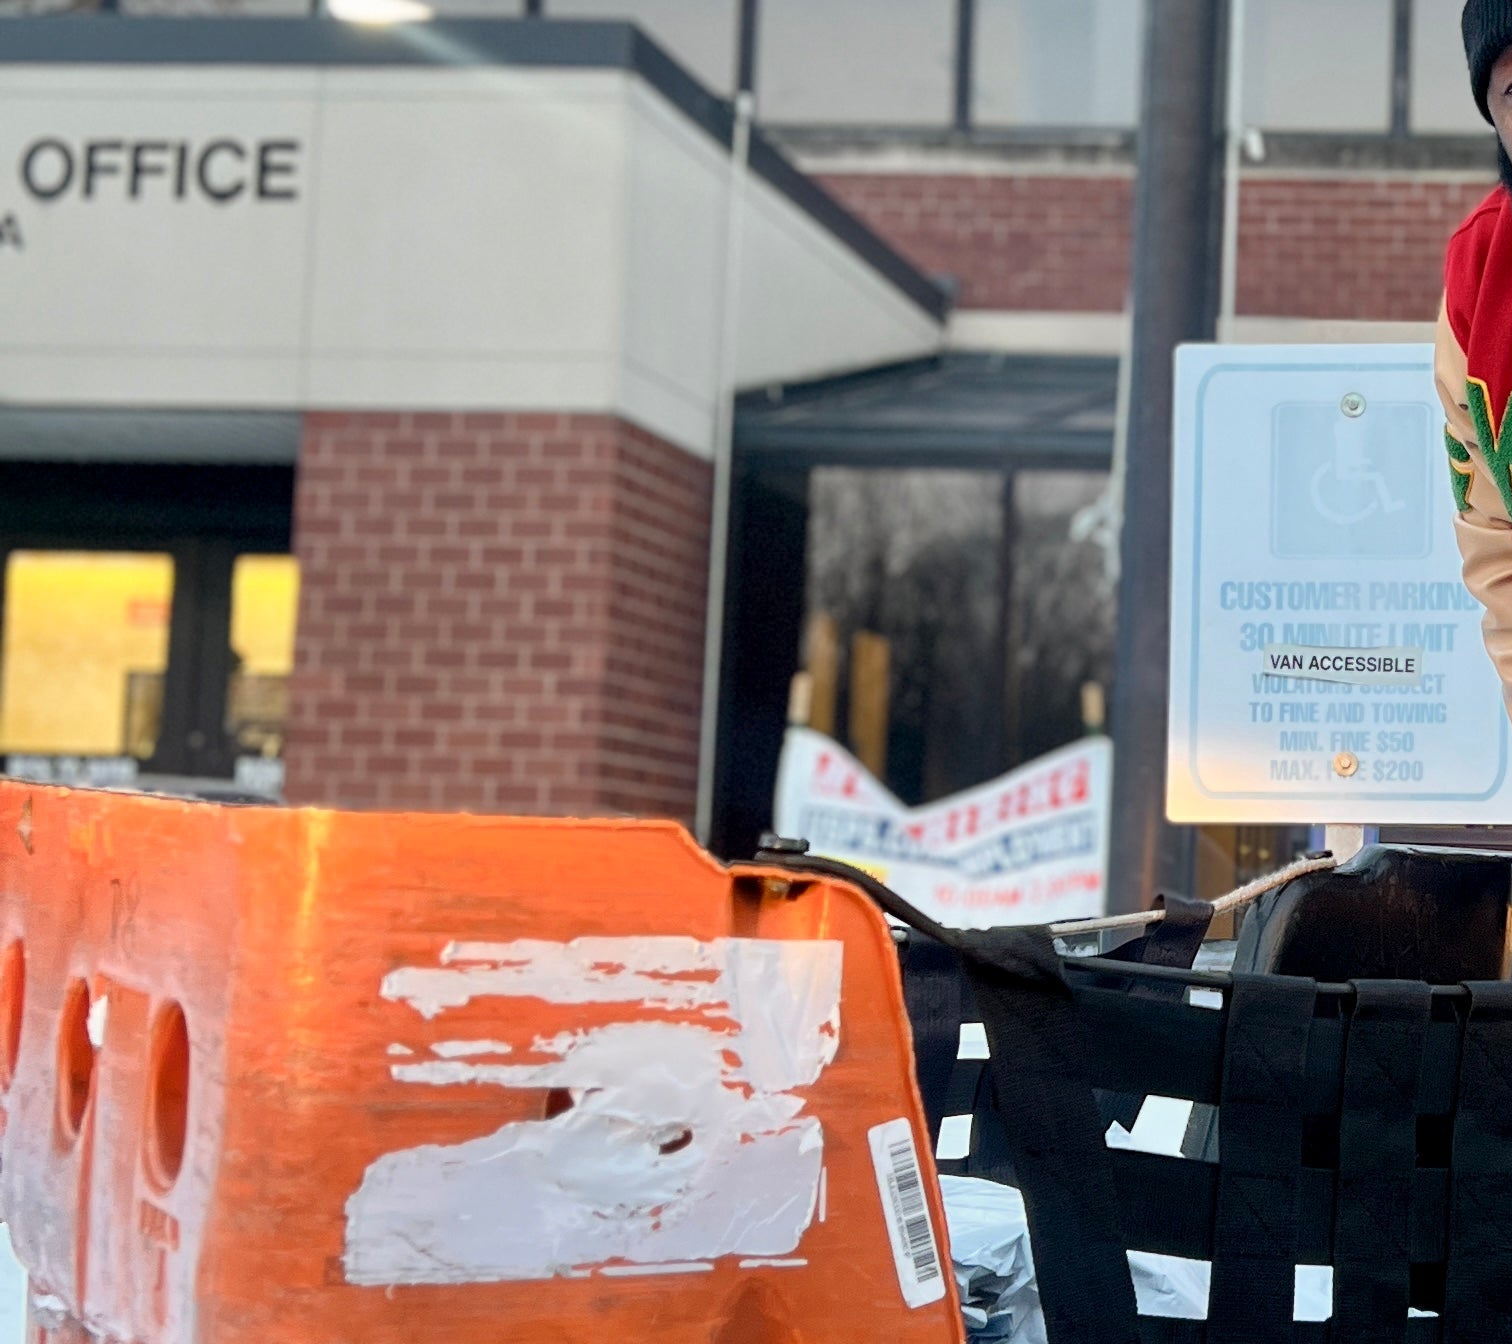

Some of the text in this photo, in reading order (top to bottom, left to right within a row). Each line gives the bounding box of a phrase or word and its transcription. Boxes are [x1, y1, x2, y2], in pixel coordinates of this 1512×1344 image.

[20, 136, 300, 204] OFFICE
[1220, 581, 1361, 610] CUSTOMER
[1239, 622, 1459, 652] 30 MINUTE LIMIT
[1270, 654, 1416, 673] VAN ACCESSIBLE
[1249, 703, 1448, 724] TO FINE AND TOWING
[1279, 730, 1415, 753] MIN. FINE $50
[1269, 759, 1424, 783] MAX. FE $200
